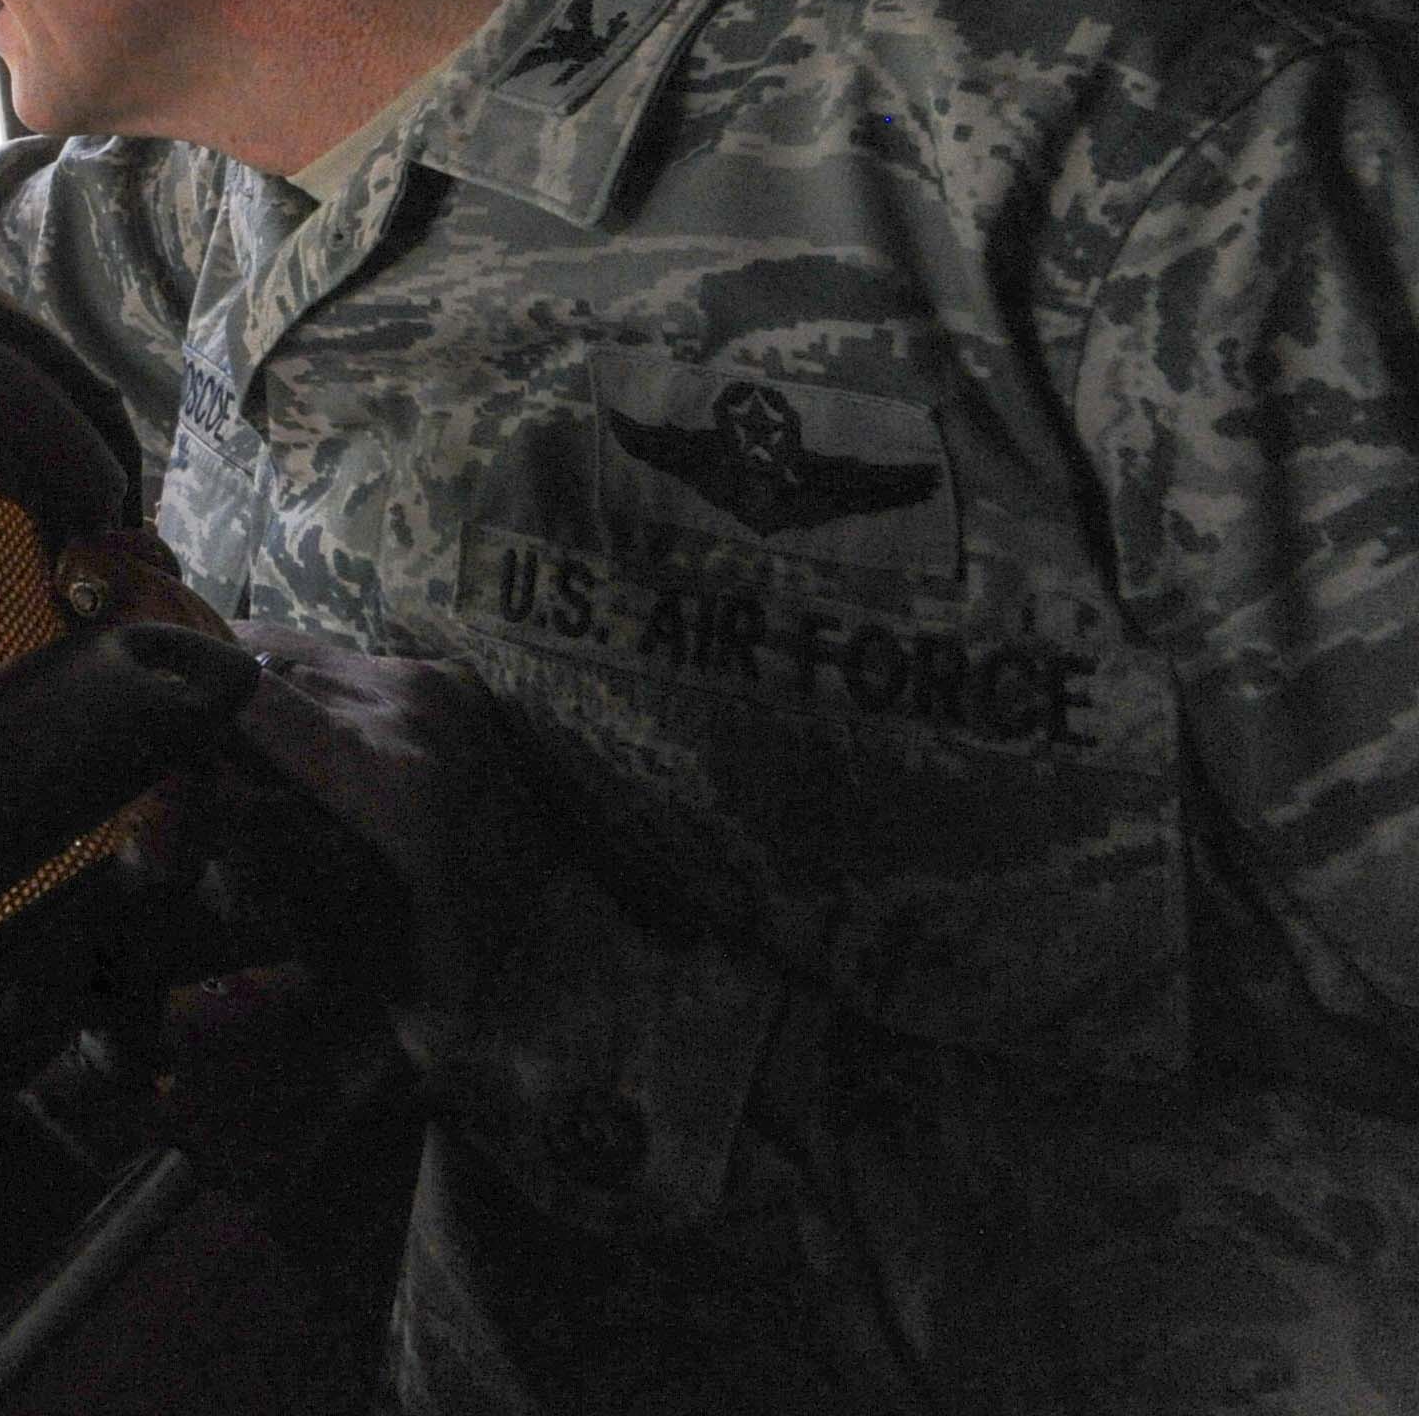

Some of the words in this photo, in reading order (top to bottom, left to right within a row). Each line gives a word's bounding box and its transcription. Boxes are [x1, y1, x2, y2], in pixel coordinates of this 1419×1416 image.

[498, 546, 611, 644] U.S.
[637, 589, 767, 680] AIR
[795, 610, 1101, 750] FORCE
